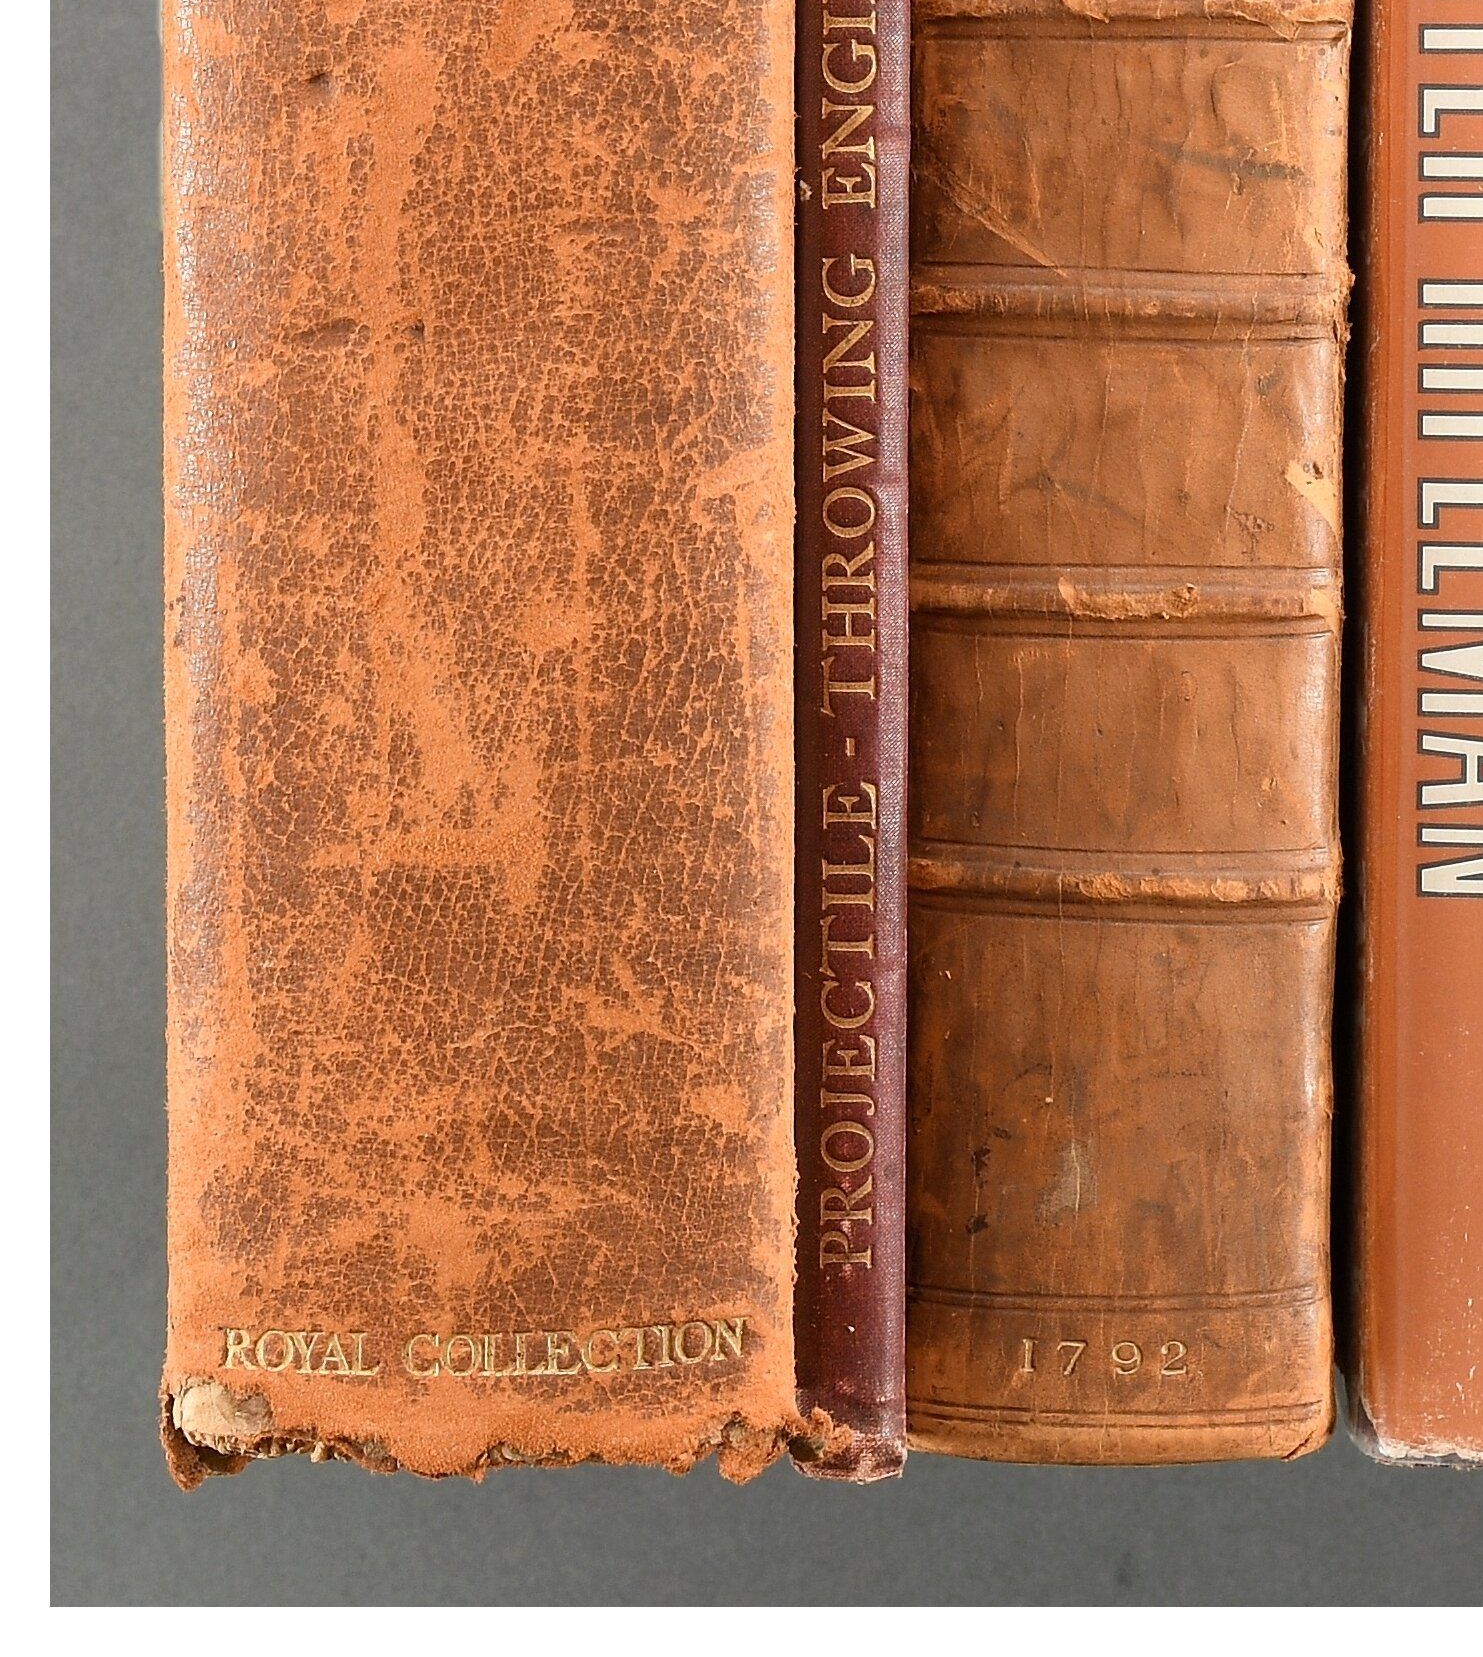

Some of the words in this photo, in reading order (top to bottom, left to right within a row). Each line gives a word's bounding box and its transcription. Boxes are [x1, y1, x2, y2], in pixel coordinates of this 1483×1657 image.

[819, 257, 878, 713] THROWING
[819, 783, 878, 1268] PROJECTILE
[223, 1326, 377, 1376] ROYAL
[404, 1316, 750, 1377] COLLECTION
[1022, 1339, 1187, 1375] 1792
